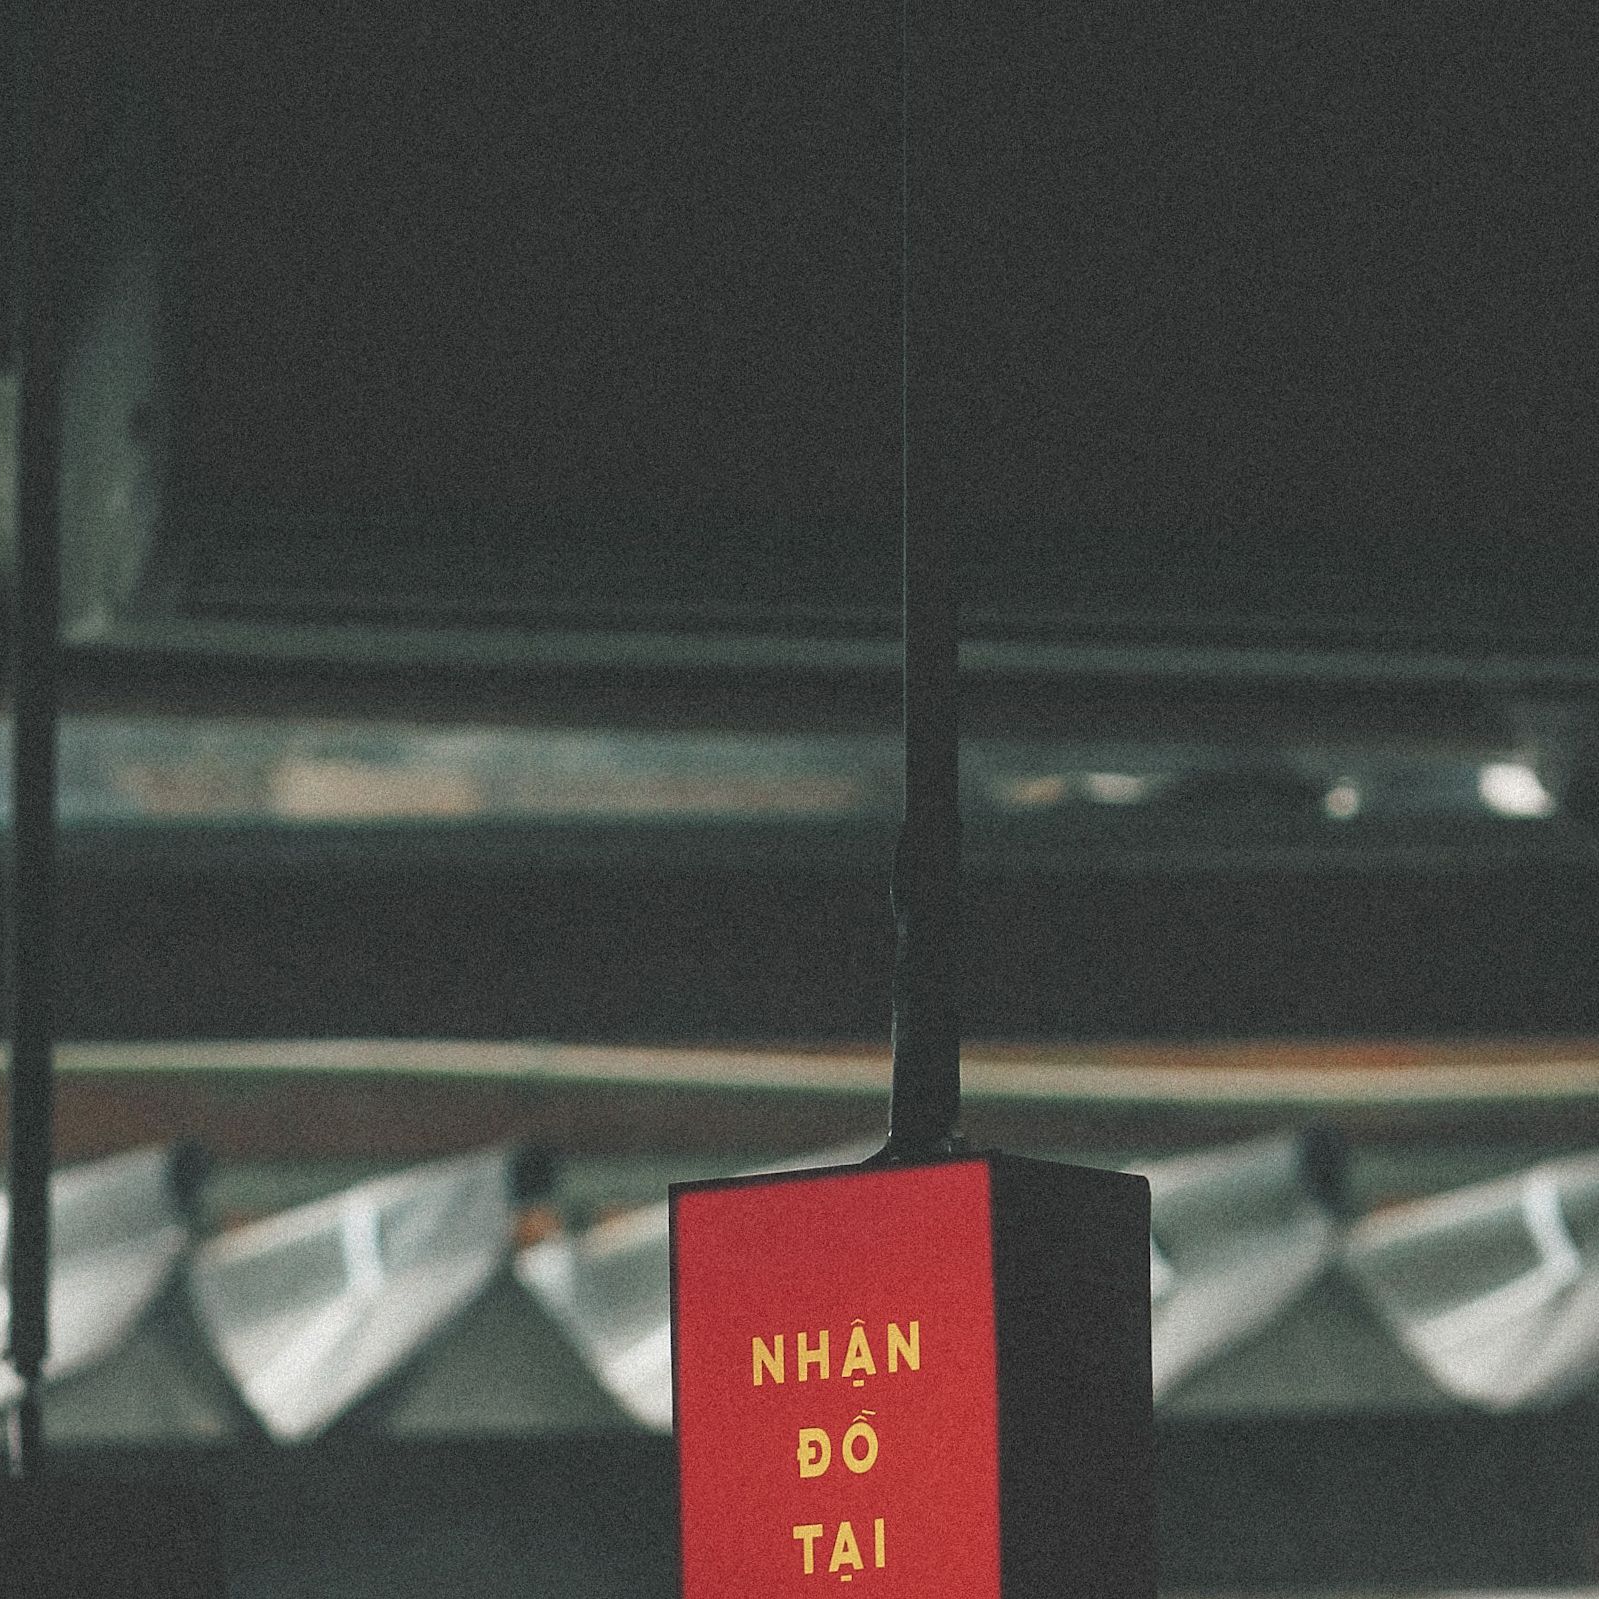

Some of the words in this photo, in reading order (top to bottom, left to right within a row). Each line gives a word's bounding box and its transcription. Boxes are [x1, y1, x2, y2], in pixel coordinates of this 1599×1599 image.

[752, 1319, 921, 1388] NHẬN
[797, 1409, 879, 1479] ĐỒ
[792, 1518, 886, 1582] TẠI
